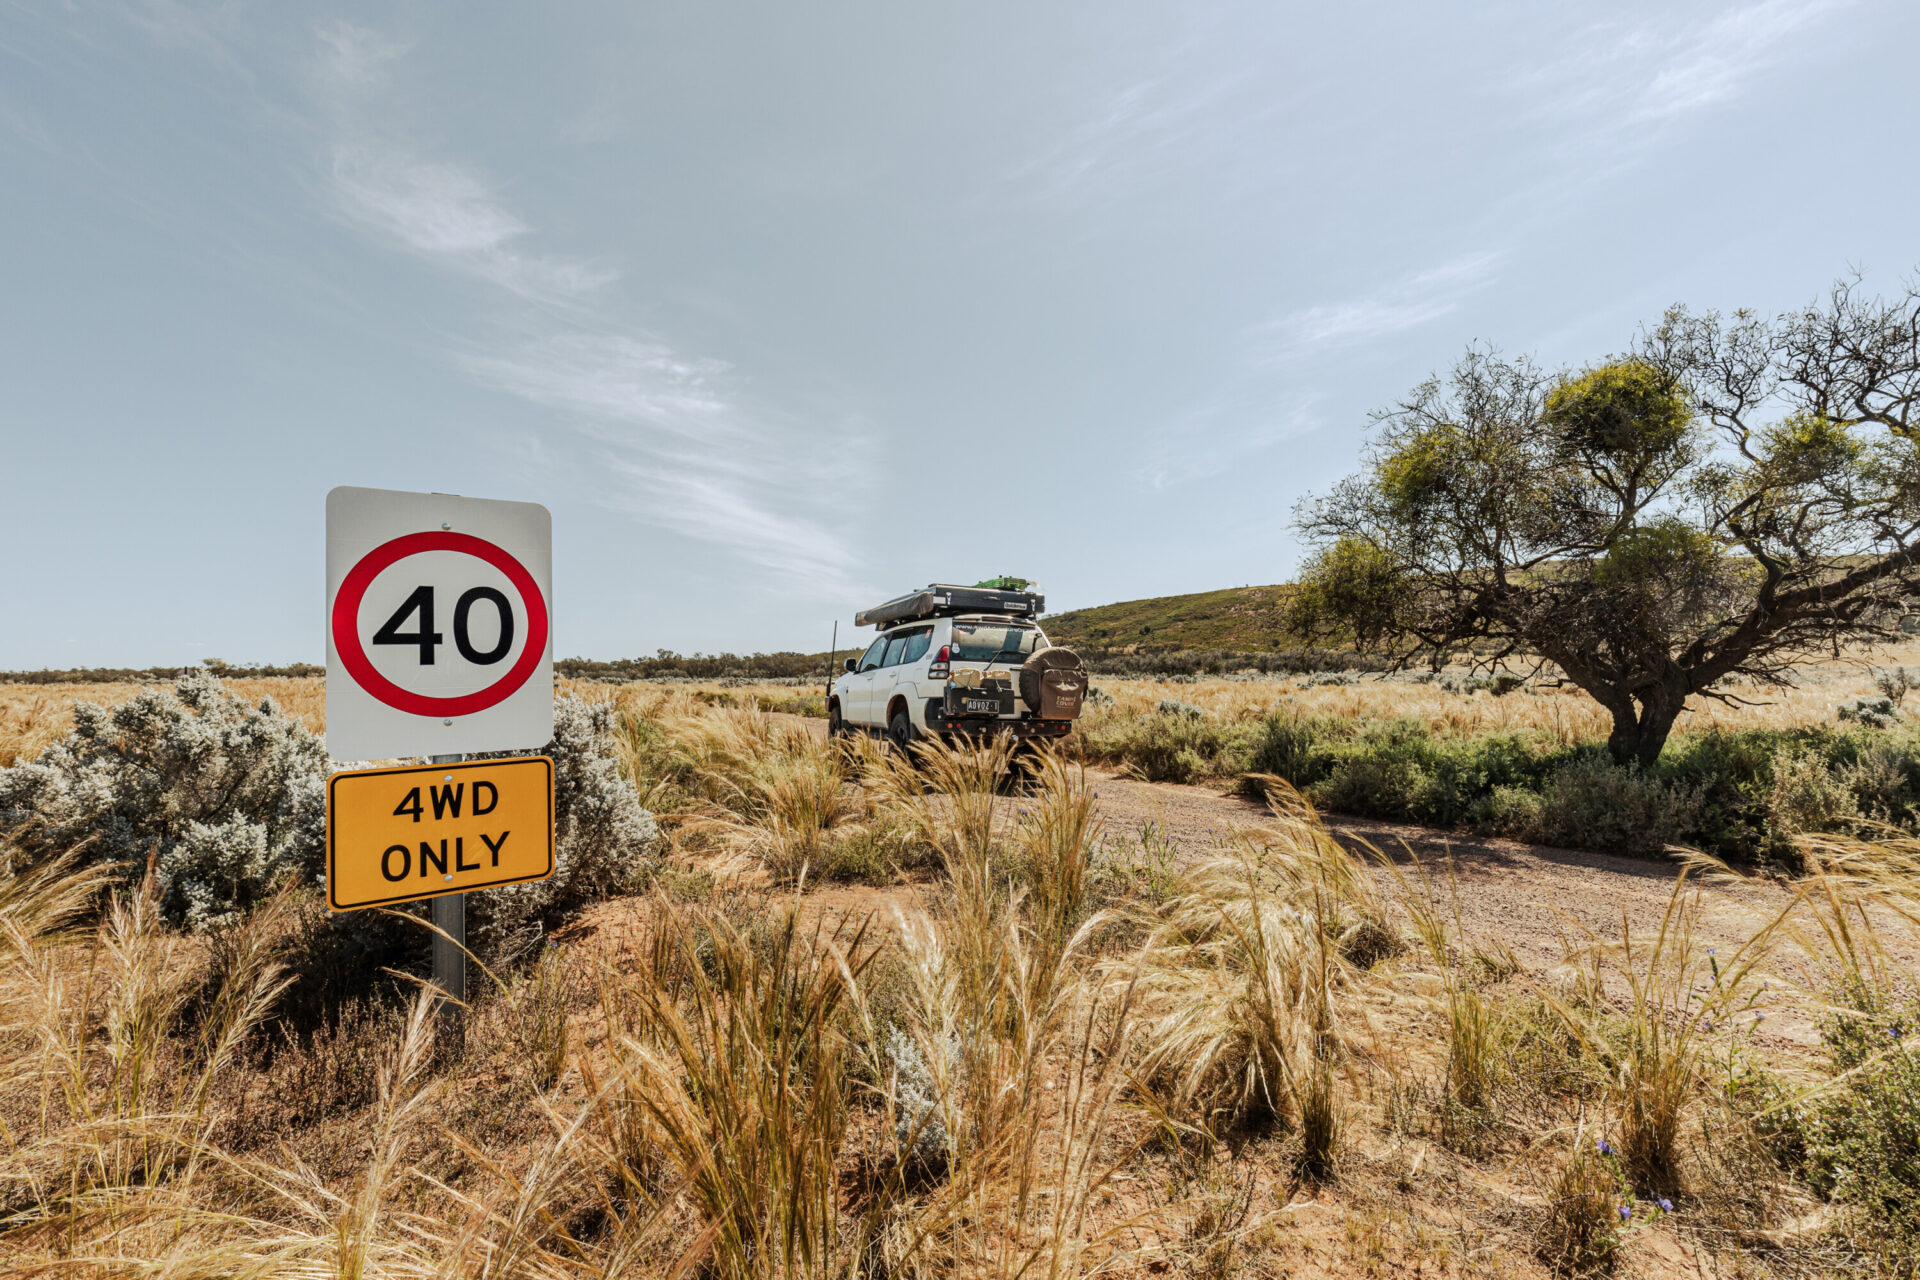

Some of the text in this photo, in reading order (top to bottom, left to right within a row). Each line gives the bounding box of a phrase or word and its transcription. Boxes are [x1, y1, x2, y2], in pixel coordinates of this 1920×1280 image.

[372, 585, 515, 666] 40
[393, 780, 499, 823] 4WD
[381, 831, 510, 882] ONLY
